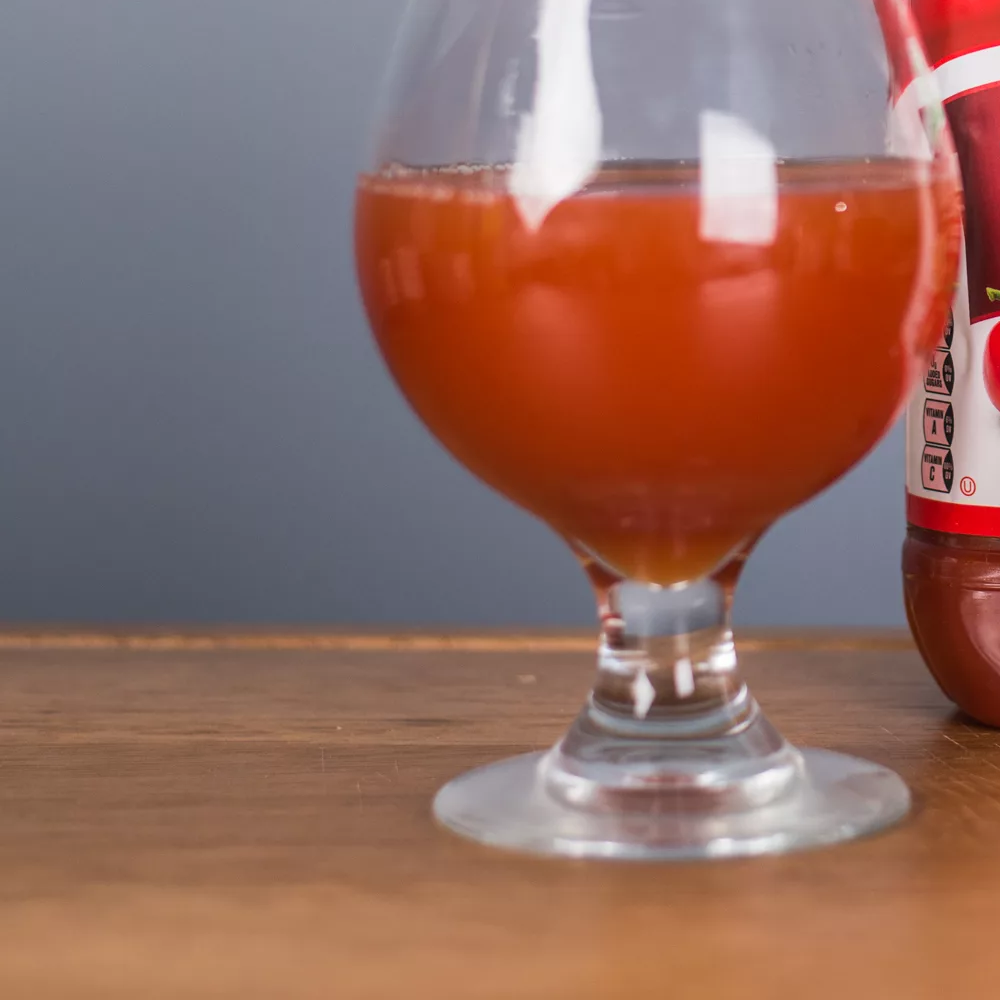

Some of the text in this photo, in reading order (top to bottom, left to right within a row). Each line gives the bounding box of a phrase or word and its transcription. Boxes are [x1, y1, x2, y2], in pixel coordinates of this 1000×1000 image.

[926, 377, 942, 388] SUGARS
[926, 407, 944, 419] VITAMIN
[931, 420, 937, 435] A
[924, 453, 942, 466] VITAMIN
[929, 466, 935, 481] C
